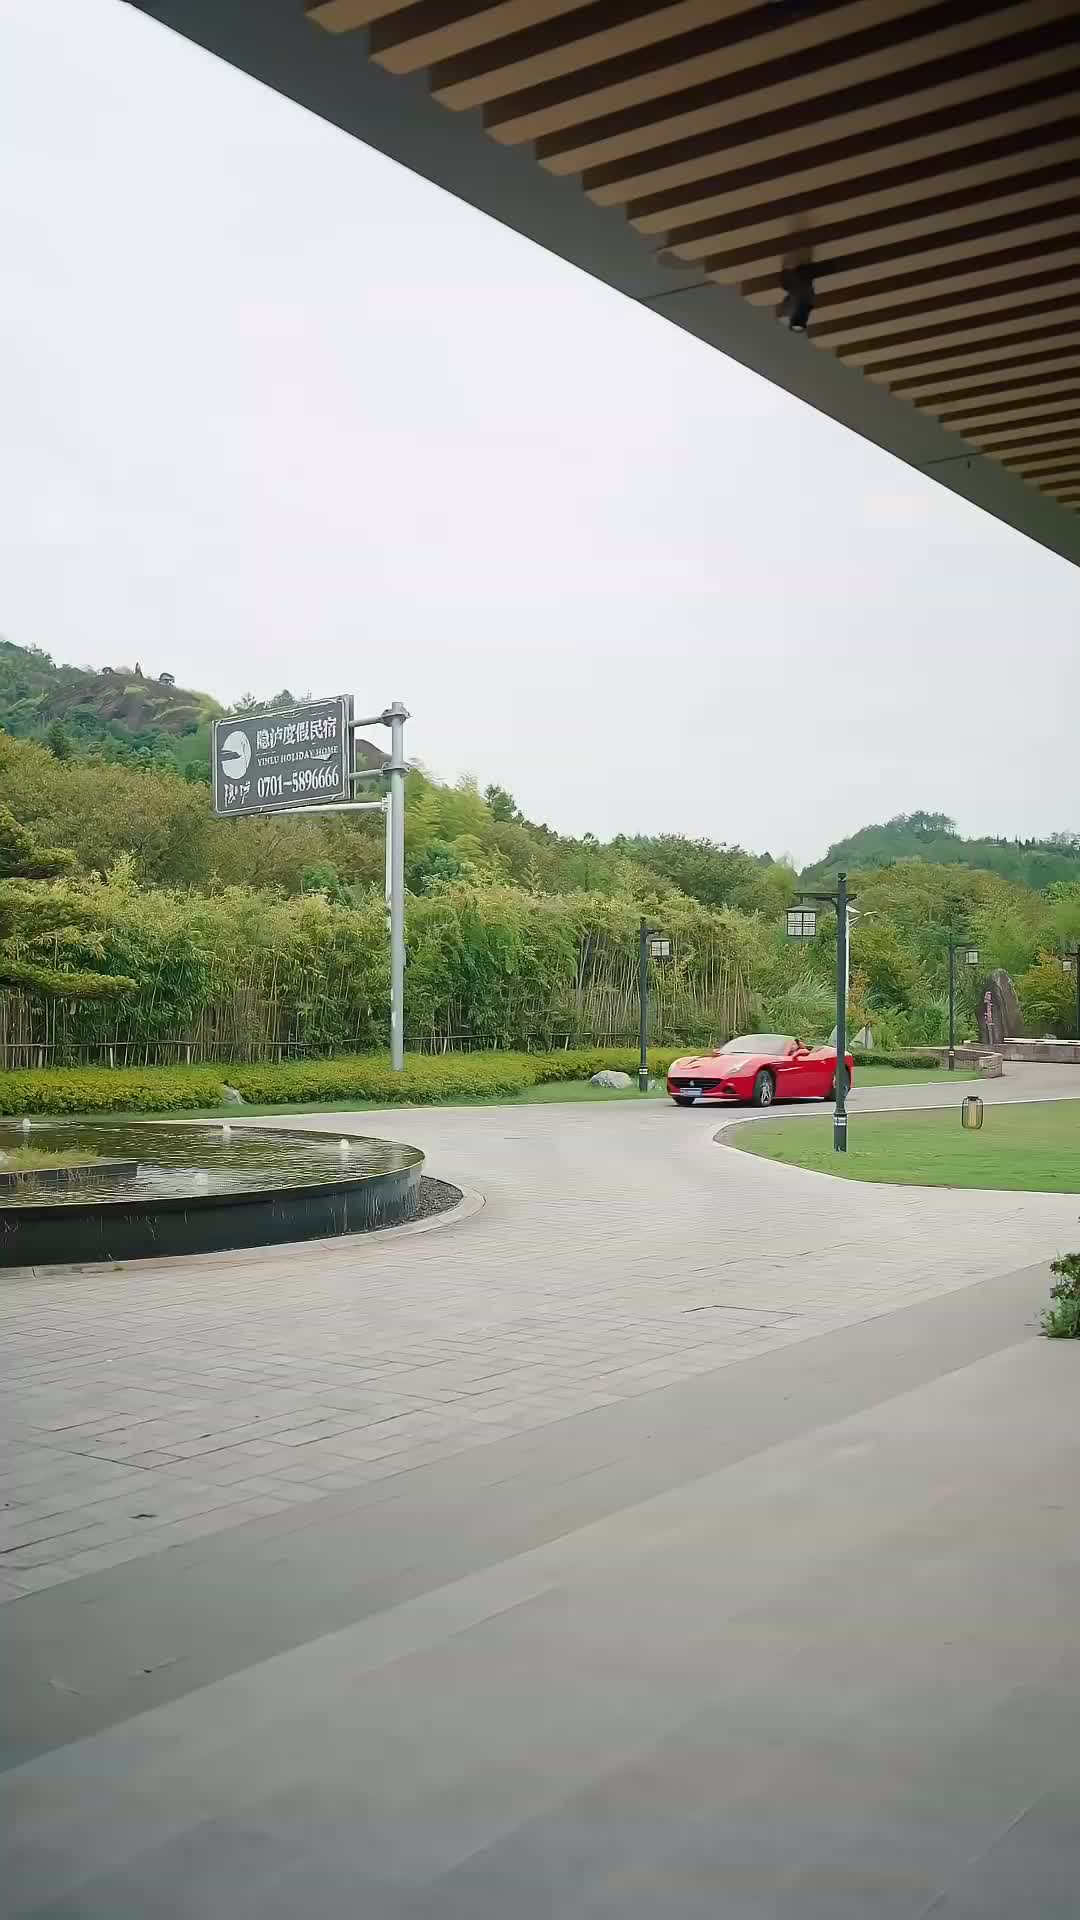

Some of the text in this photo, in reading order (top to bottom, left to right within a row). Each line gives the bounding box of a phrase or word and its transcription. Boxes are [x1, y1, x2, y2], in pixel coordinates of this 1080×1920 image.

[281, 749, 314, 763] HOLIDAY
[316, 745, 339, 756] HOME
[257, 764, 339, 798] 0701-5896666
